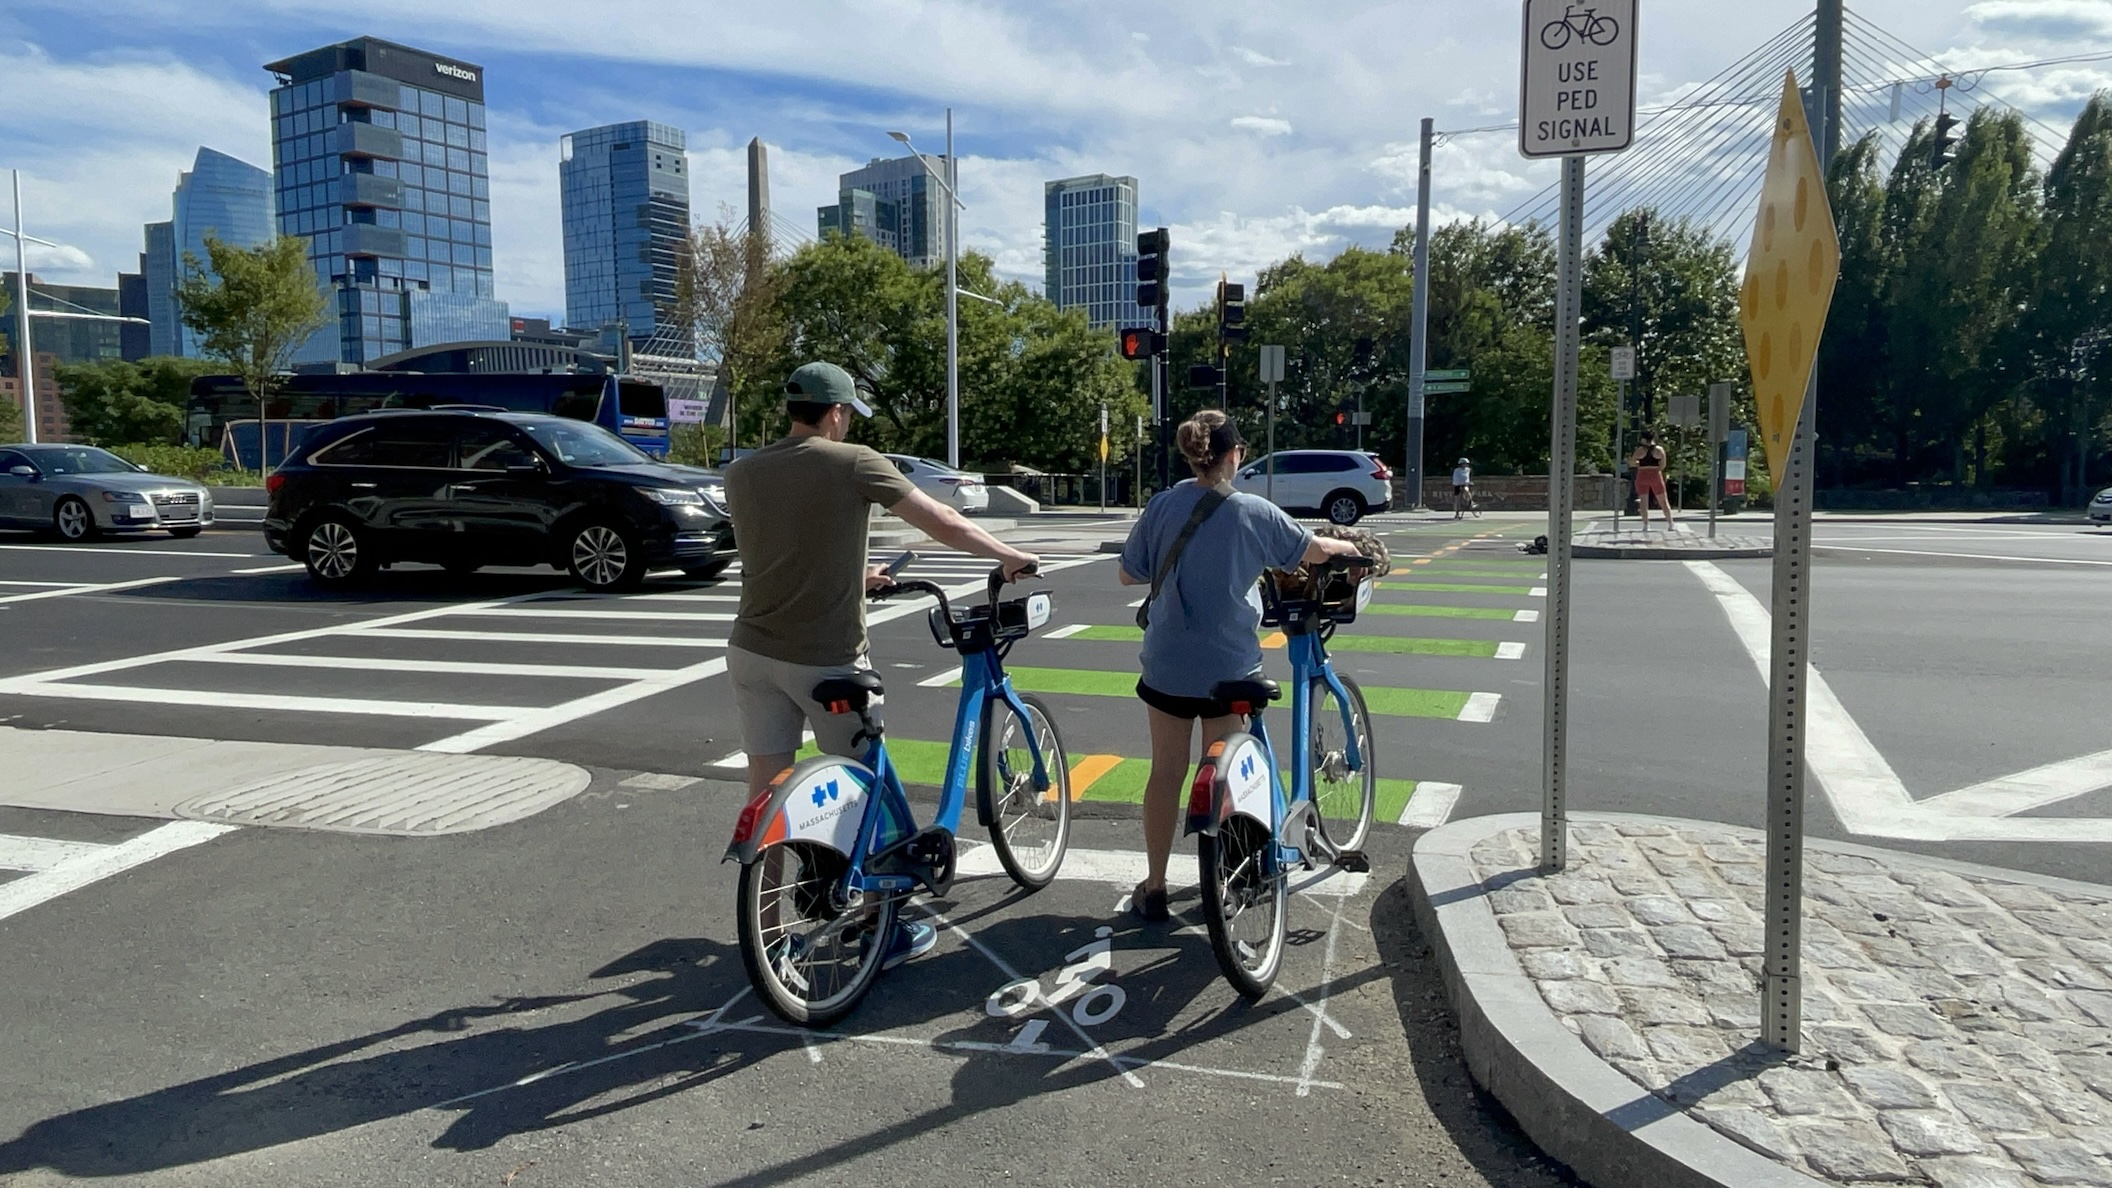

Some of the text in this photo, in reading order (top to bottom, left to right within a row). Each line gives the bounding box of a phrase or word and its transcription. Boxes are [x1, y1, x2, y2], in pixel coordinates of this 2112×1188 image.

[435, 62, 476, 82] verizon
[1558, 60, 1599, 83] USE
[1557, 89, 1598, 111] PED
[1537, 116, 1616, 141] SIGNAL
[799, 800, 859, 830] MASSACHUSETTS
